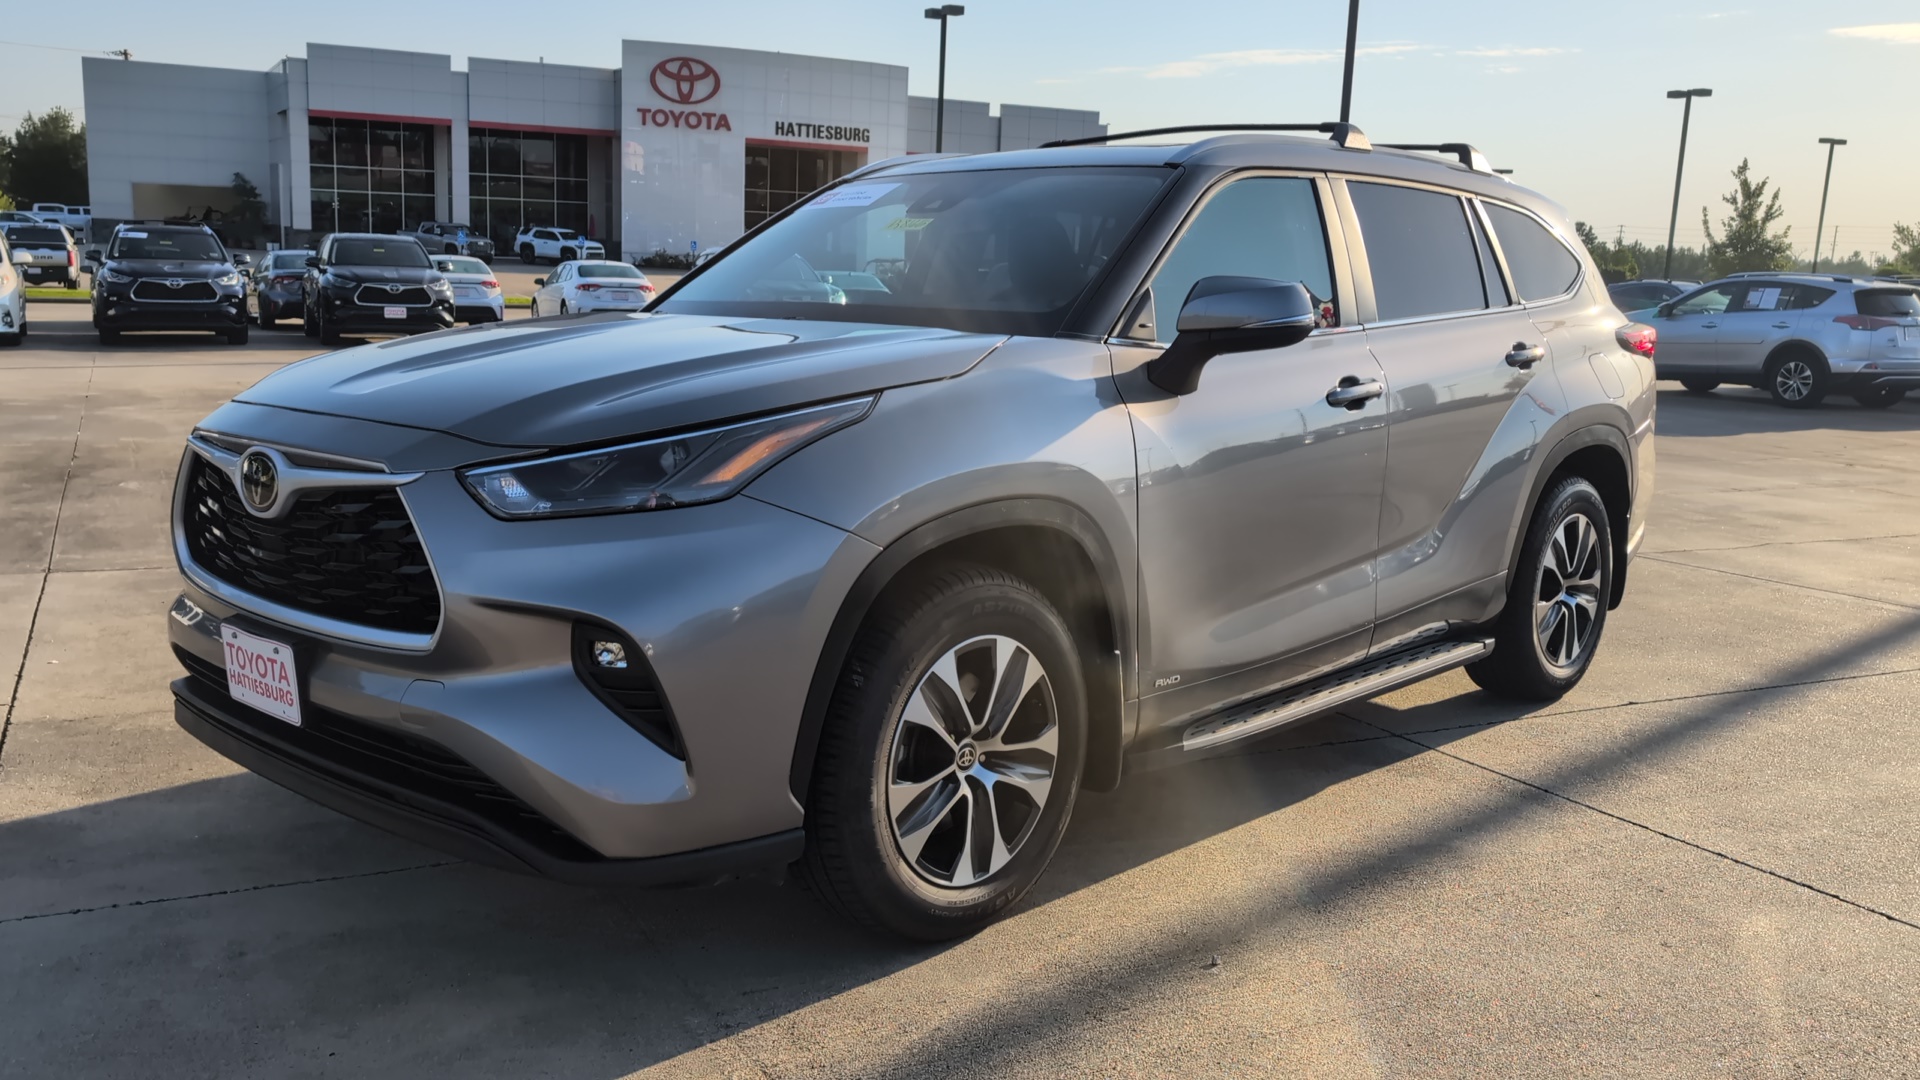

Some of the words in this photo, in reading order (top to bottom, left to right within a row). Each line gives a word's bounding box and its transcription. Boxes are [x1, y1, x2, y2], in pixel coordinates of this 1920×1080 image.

[637, 108, 732, 131] TOYOTA
[775, 121, 871, 143] HATTIESBURG
[226, 641, 291, 687] TOYOTA
[229, 668, 294, 707] HATTIESBURG
